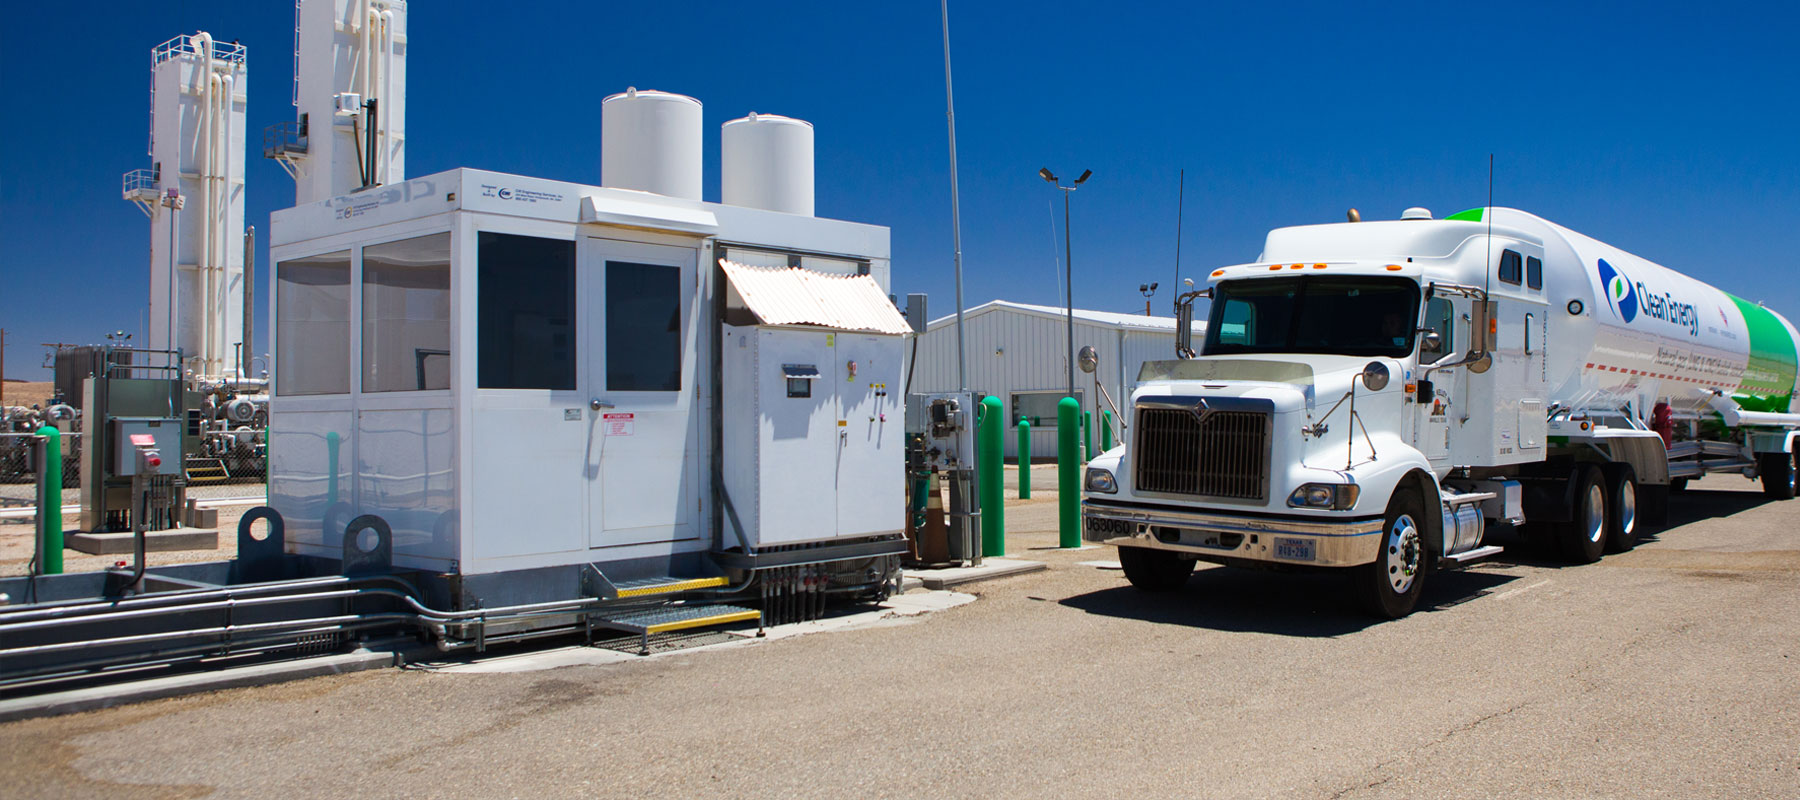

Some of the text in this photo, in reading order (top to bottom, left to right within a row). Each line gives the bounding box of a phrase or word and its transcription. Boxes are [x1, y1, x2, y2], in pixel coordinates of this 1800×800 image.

[1636, 281, 1699, 336] Clean Energy
[1086, 517, 1130, 534] 063060
